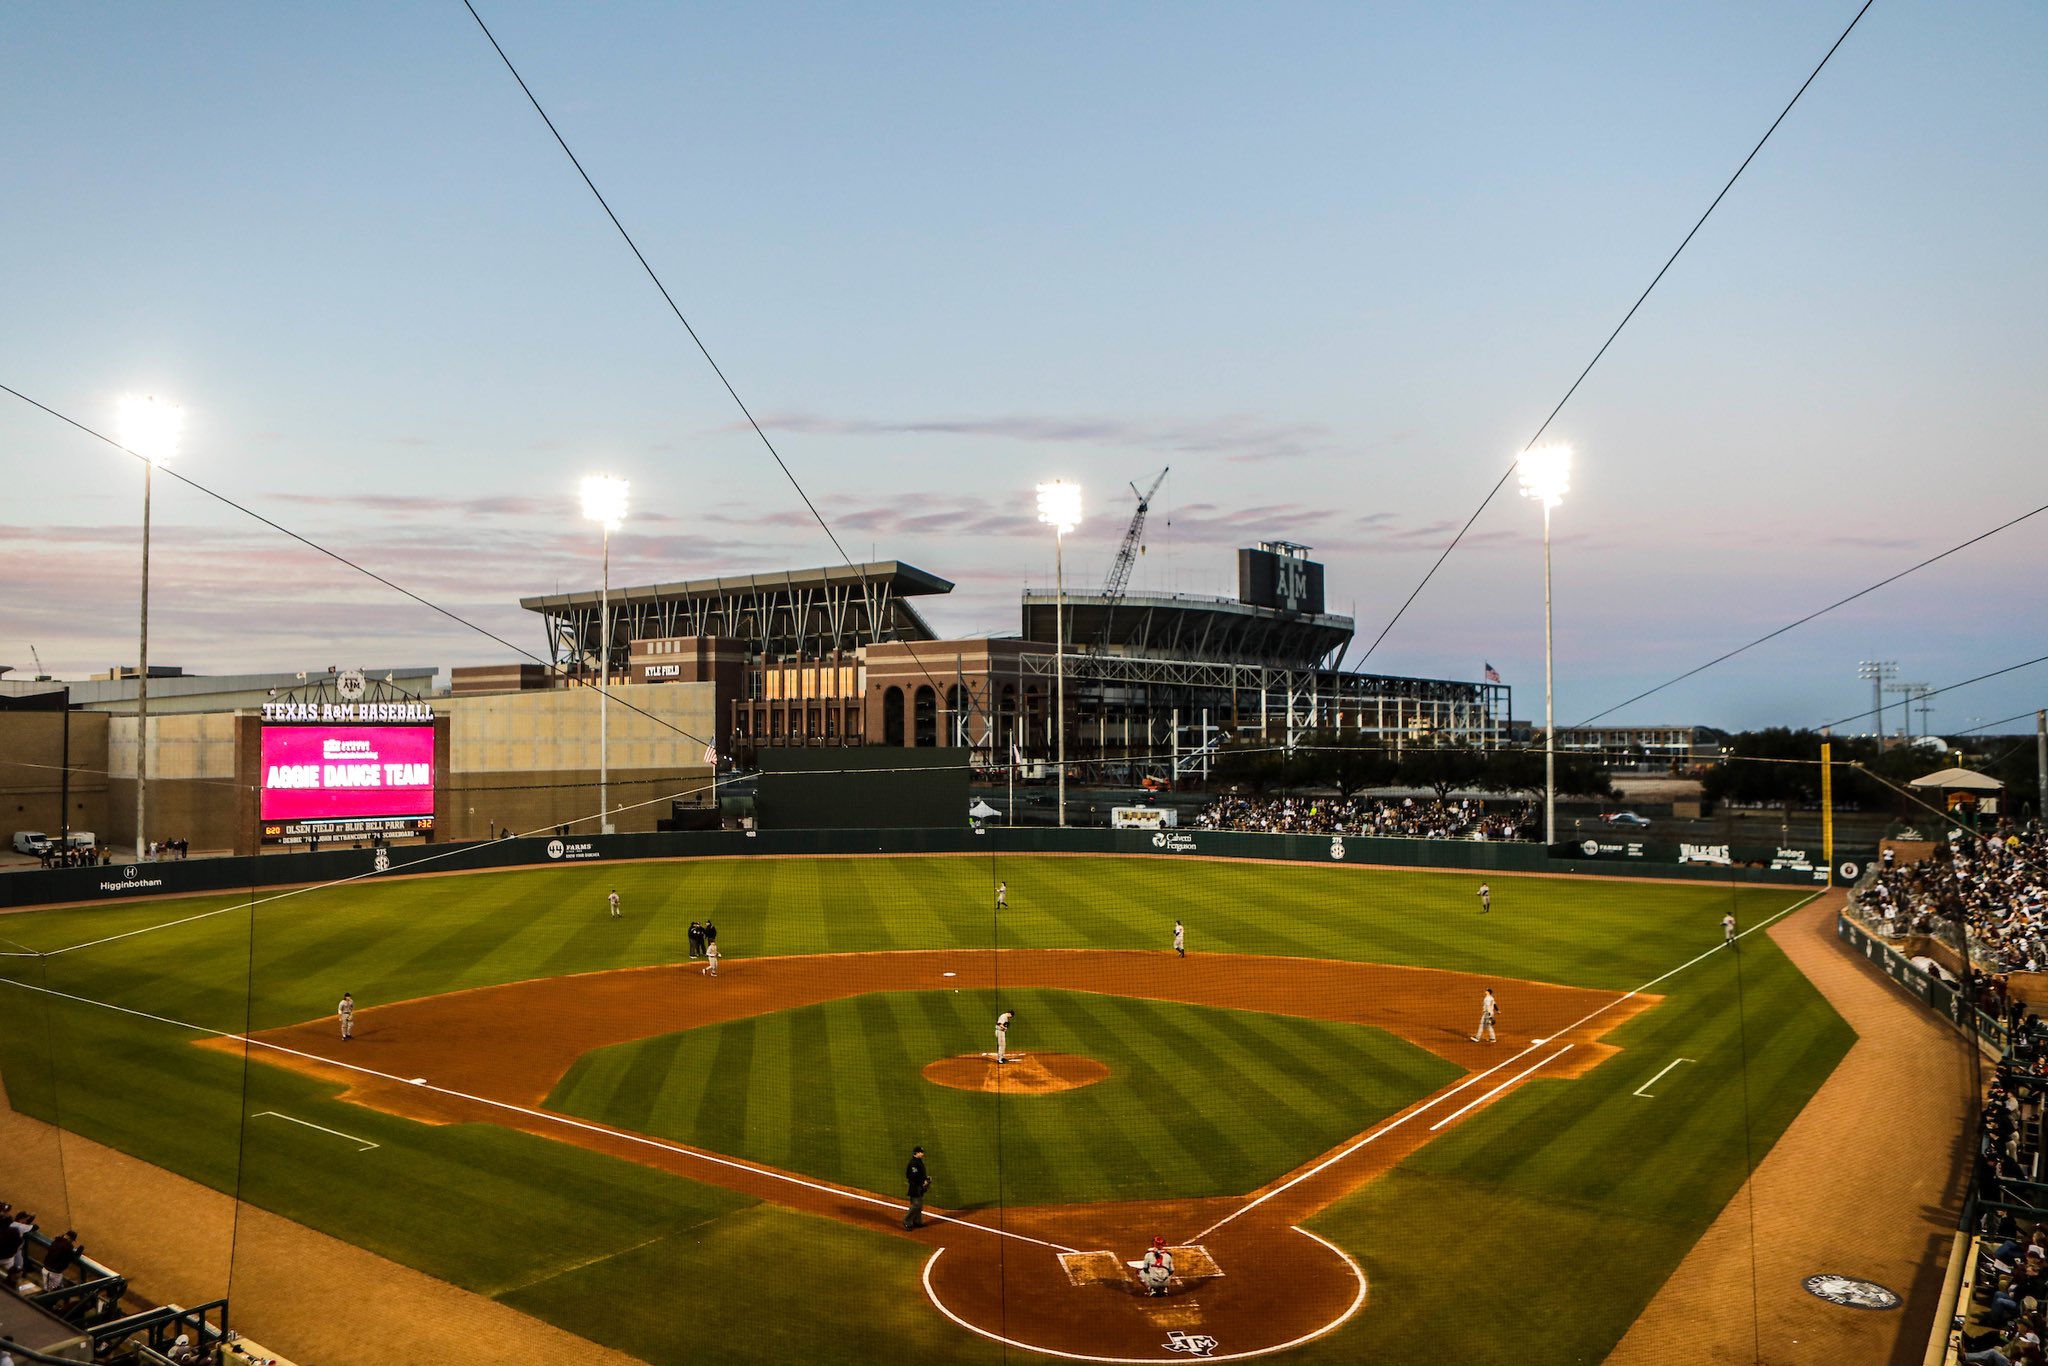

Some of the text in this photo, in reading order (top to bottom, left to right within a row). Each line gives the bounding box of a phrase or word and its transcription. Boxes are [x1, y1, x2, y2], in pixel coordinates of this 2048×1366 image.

[645, 664, 680, 676] KYLE FIELD
[262, 703, 434, 720] TEXAS A&M BASEBALL
[267, 763, 429, 788] AGGIE DANCE TEAM
[285, 824, 311, 834] OLSEN
[312, 823, 335, 833] FIELD
[345, 822, 364, 832] BLUE
[365, 821, 384, 831] BELL
[385, 820, 405, 830] PARK
[1166, 832, 1192, 842] Calvetti
[1166, 841, 1197, 852] Ferguson
[1776, 847, 1806, 861] integ
[100, 879, 162, 891] Higginbotham
